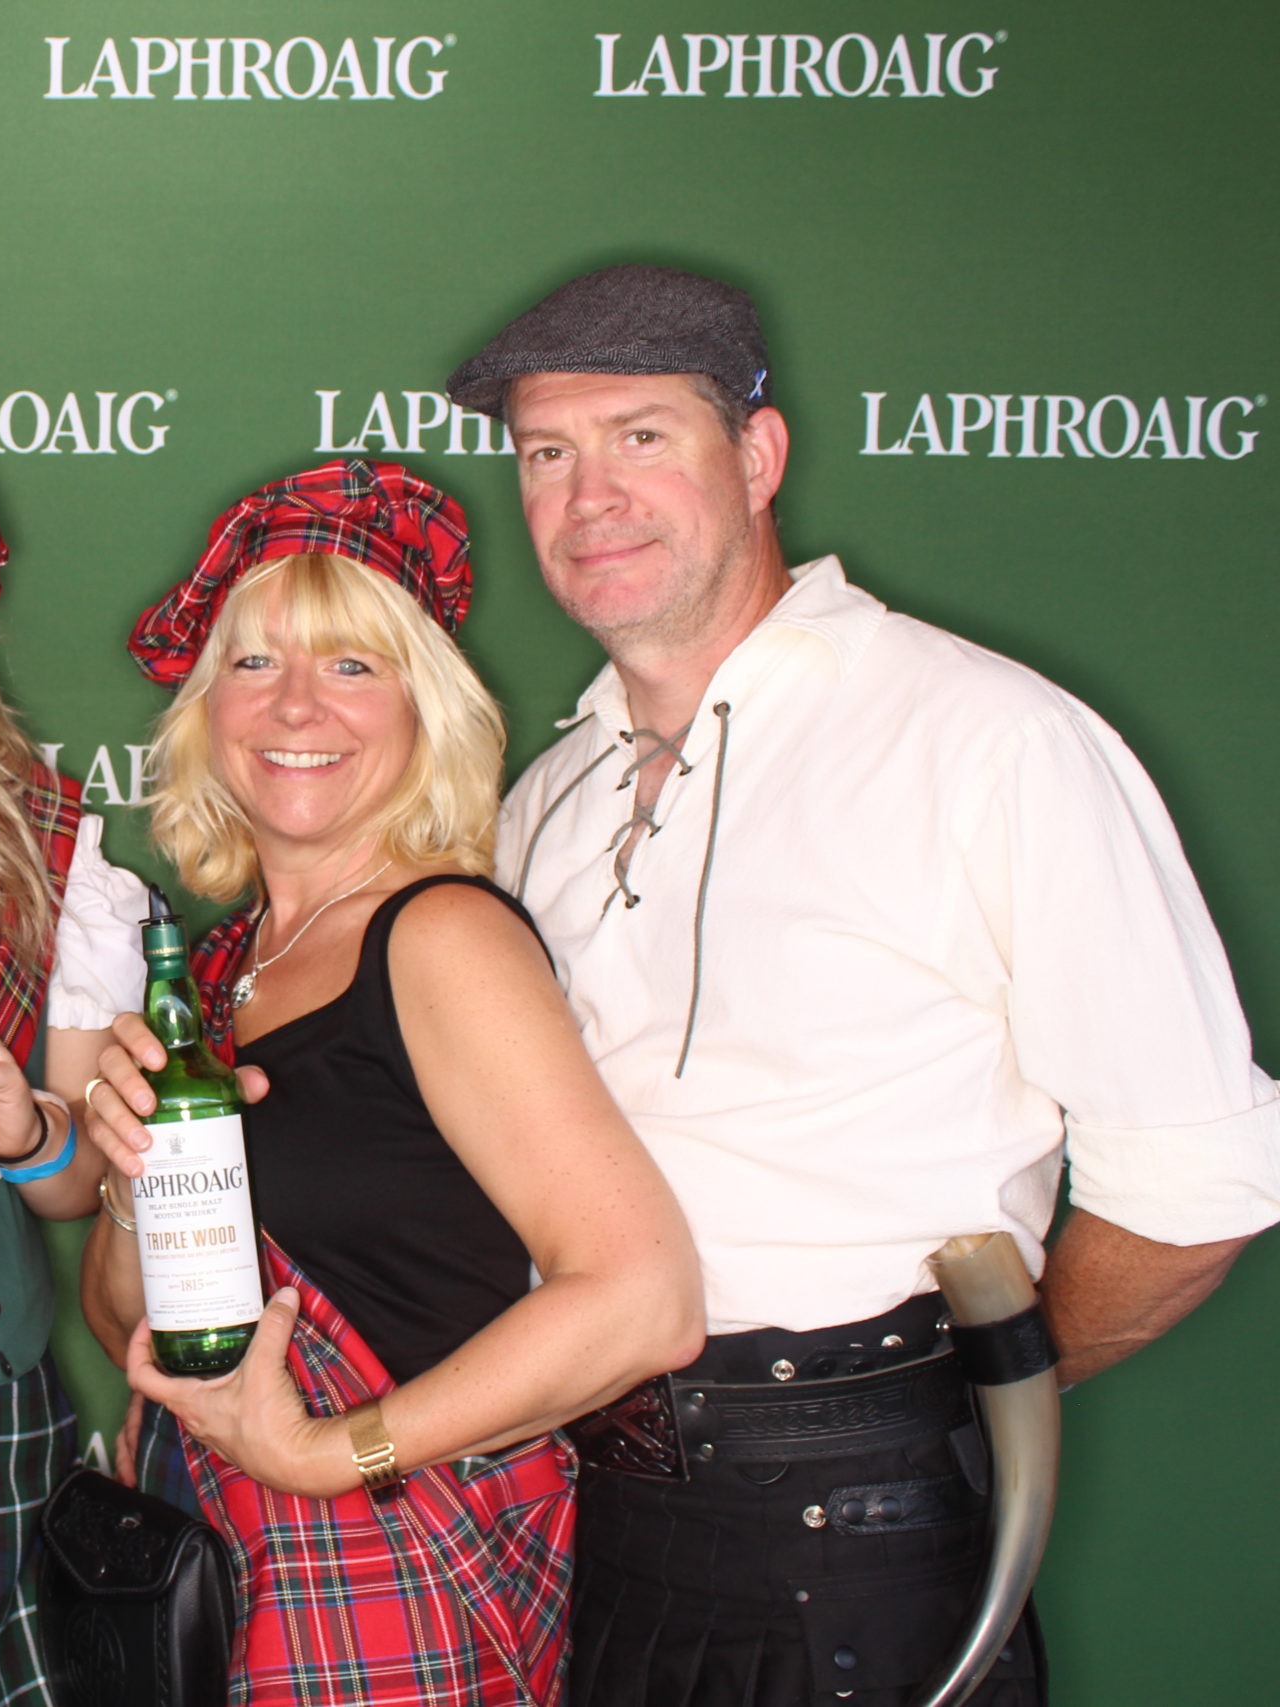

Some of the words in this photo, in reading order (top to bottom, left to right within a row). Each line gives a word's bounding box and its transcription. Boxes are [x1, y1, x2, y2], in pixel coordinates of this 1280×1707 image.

[43, 36, 449, 100] LAPHROAIG
[593, 32, 1000, 98] LAPHROAIG
[860, 393, 1260, 460] LAPHROAIG
[132, 1165, 244, 1198] LAPHROAIG
[146, 1231, 189, 1251] TRIPLE
[192, 1225, 237, 1248] WOOD
[180, 1279, 204, 1292] 1815
